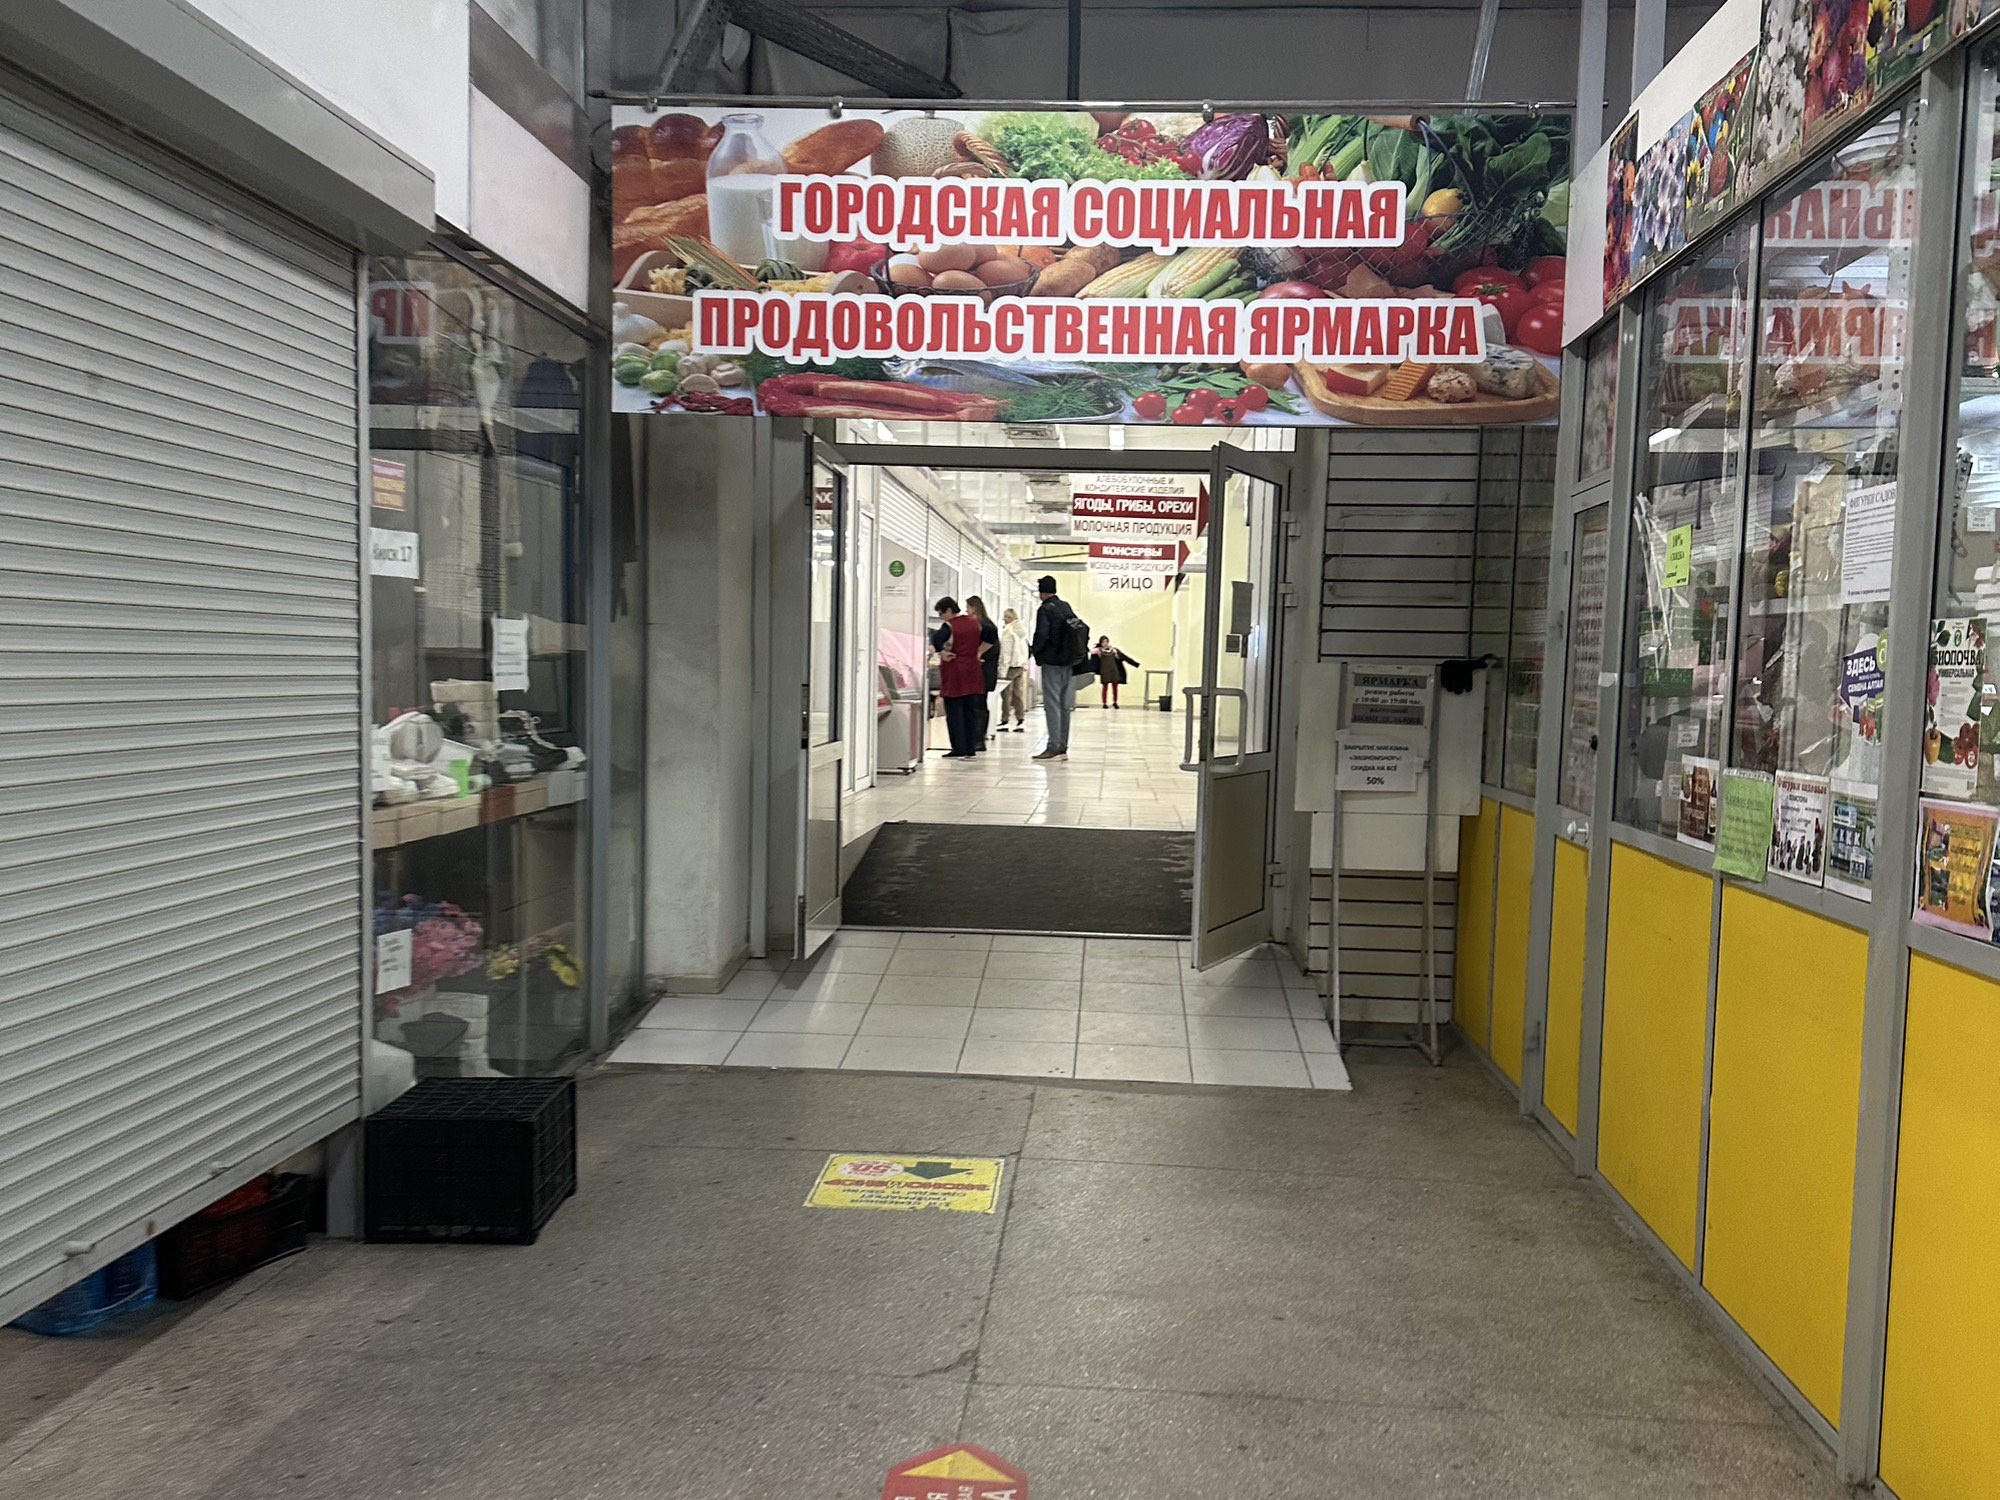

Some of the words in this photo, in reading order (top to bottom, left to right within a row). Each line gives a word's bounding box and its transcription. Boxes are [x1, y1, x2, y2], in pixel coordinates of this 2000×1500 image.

[780, 182, 1061, 244] ГОРОДСКАЯ
[1073, 185, 1397, 247] СОЦИАЛЬНАЯ
[700, 297, 1237, 357] ПРОДОВОЛЬСТВЕННАЯ
[1250, 306, 1479, 356] ЯРМАРКА
[1148, 486, 1184, 495] ИЗДЕЛИЯ
[1073, 497, 1114, 513] ЯГОДЫ,
[1116, 499, 1156, 514] ГРИБЫ,
[1157, 500, 1194, 514] ОРЕХИ
[1074, 519, 1129, 533] МОЛОЧНАЯ
[1132, 521, 1192, 537] ПРОДУКЦИЯ
[1102, 546, 1162, 557] КОНСЕРВЫ
[1131, 562, 1174, 572] ПРОДУКЦИЯ
[1109, 575, 1153, 590] ЯЙЦО
[1933, 650, 1981, 666] БИОПОЧВА
[1846, 655, 1876, 677] ЗДЕСЬ
[1362, 676, 1419, 687] ЯРМАРКА
[1848, 681, 1867, 693] СЕМЕНА
[1867, 679, 1884, 690] АЛТАЯ
[1366, 776, 1385, 785] 50%
